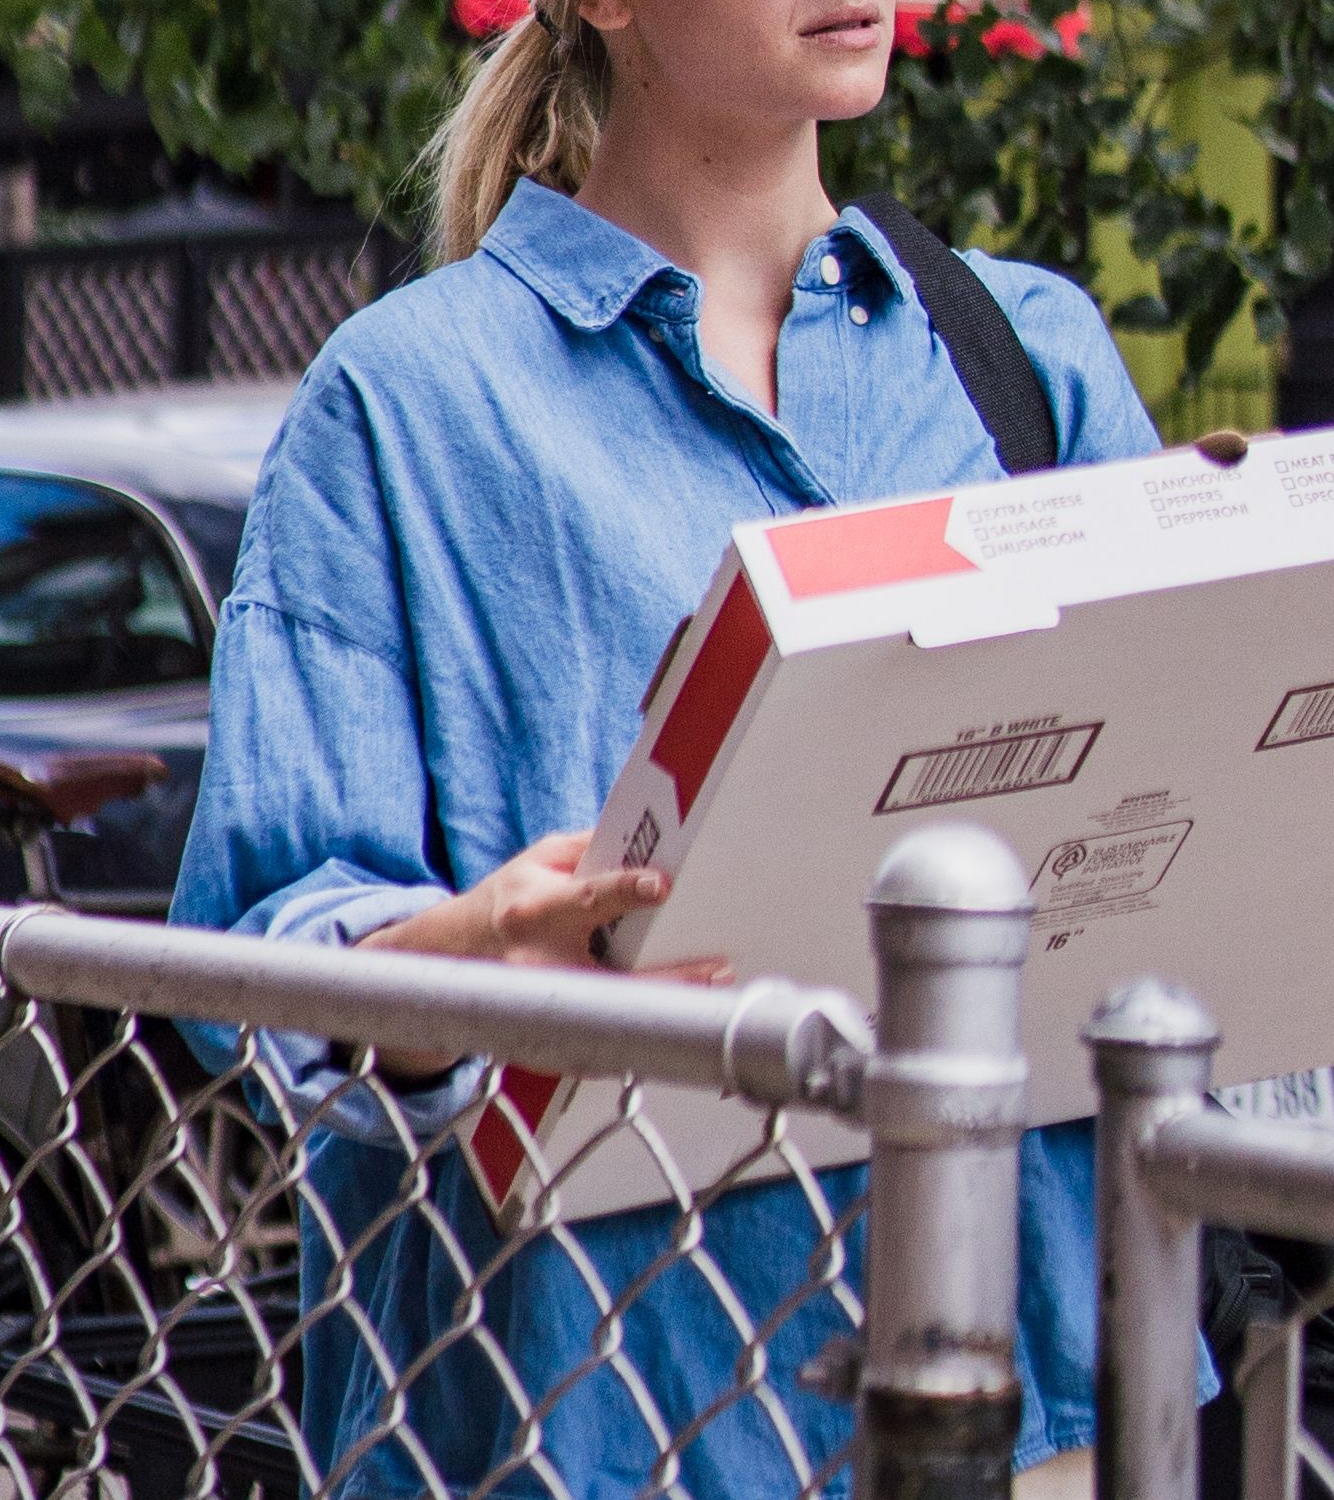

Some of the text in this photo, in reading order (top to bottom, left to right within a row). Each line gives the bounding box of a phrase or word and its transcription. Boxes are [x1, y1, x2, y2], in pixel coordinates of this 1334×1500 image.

[1291, 454, 1324, 470] MEAT
[1161, 469, 1243, 491] ANCHOVIES
[984, 494, 1084, 520] EXTRA CHEESE
[1167, 489, 1223, 508] PEPPERS
[1173, 503, 1249, 525] PEPPERONI
[990, 517, 1059, 537] SAUSAGE
[998, 530, 1086, 555] MUSHROOM
[990, 726, 1002, 739] B
[1008, 715, 1063, 734] WHITE
[1093, 834, 1177, 856] SUSTAINABLE
[1045, 927, 1085, 951] 16"
